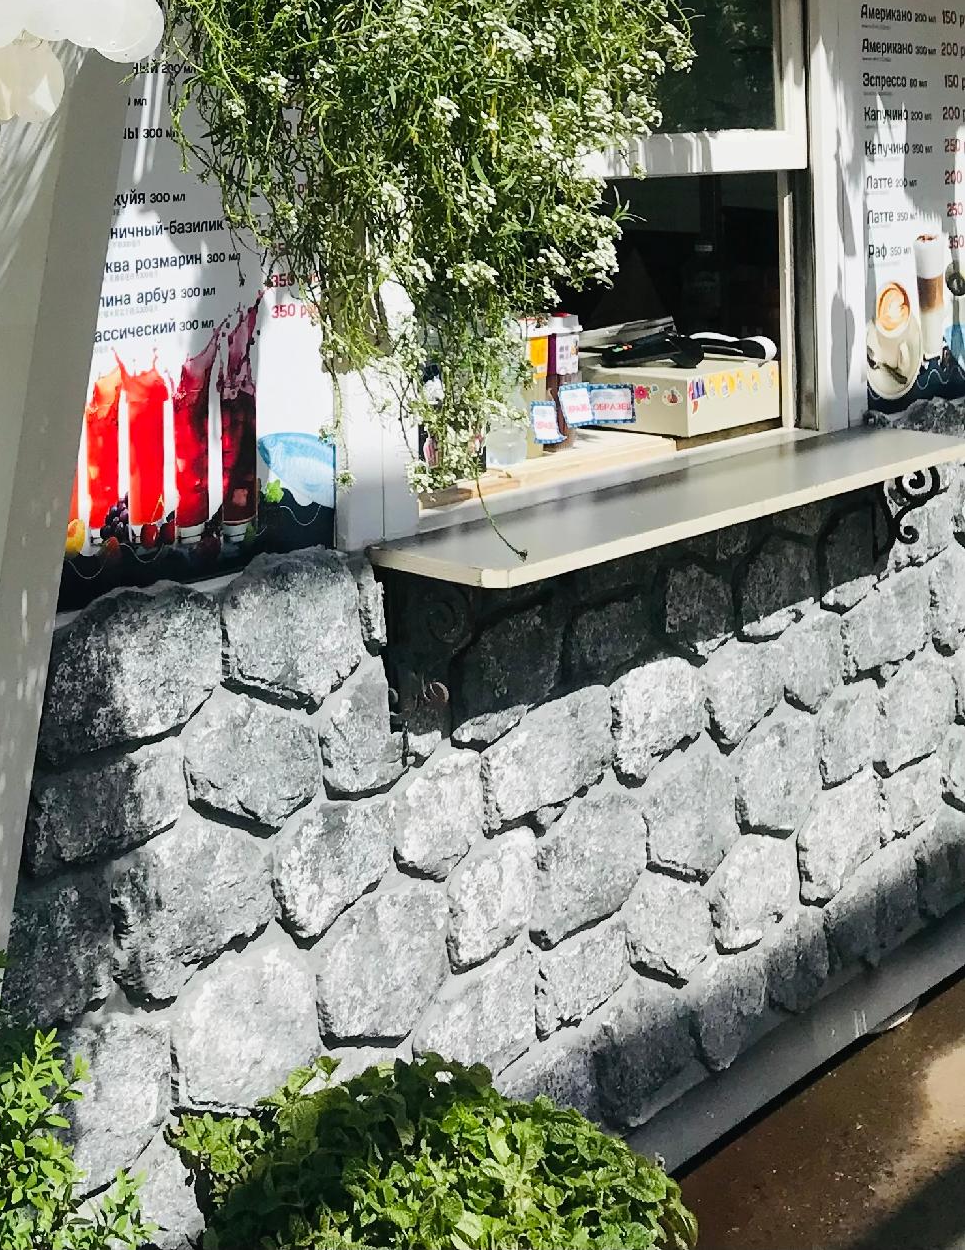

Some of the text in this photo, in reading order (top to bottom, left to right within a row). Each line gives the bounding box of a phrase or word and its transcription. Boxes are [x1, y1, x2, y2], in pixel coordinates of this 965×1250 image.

[861, 4, 913, 24] Американо
[942, 10, 957, 25] 150
[862, 38, 914, 57] Американо
[941, 42, 959, 57] 200
[863, 72, 907, 91] Эспрессо
[944, 74, 959, 89] 150
[864, 106, 910, 125] Капучино
[942, 106, 961, 121] 200
[142, 128, 163, 140] 300
[864, 139, 910, 157] Капучино
[866, 175, 893, 191] Латте
[944, 170, 963, 186] 200
[149, 192, 171, 204] 300
[172, 193, 186, 203] мл
[867, 210, 894, 225] Латте
[134, 251, 203, 271] розмарин
[206, 252, 226, 265] 300
[868, 243, 888, 261] Раф
[136, 287, 176, 306] арбуз
[180, 287, 201, 300] 300
[202, 286, 216, 298] мл
[271, 302, 296, 319] 350
[178, 320, 199, 332] 300
[200, 319, 215, 330] мл
